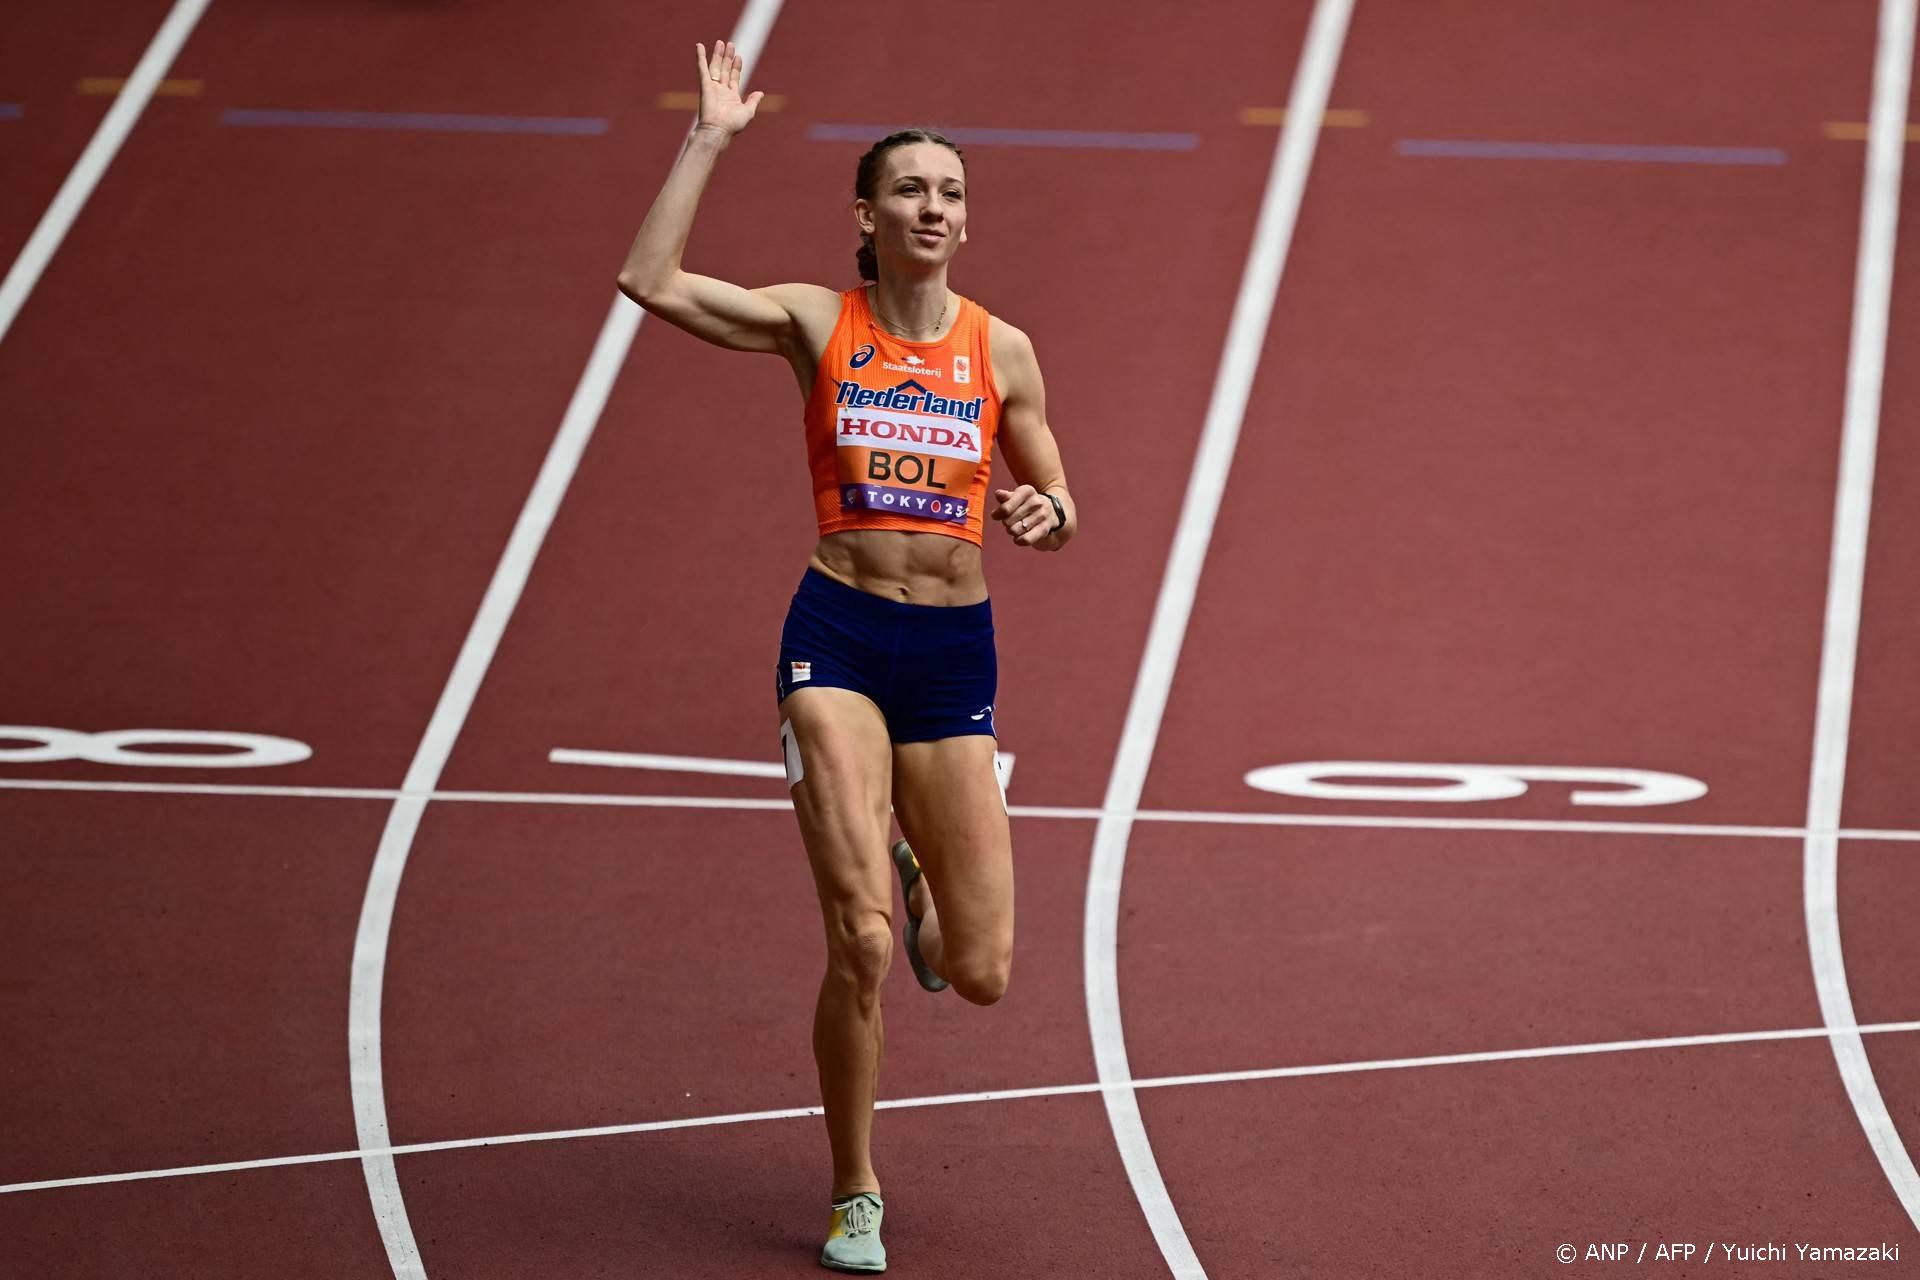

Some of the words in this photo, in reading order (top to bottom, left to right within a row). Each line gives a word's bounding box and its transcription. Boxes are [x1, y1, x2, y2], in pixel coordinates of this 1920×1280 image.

[882, 361, 942, 378] Staatsloterij
[839, 417, 979, 452] HONDA
[867, 451, 947, 489] BOL
